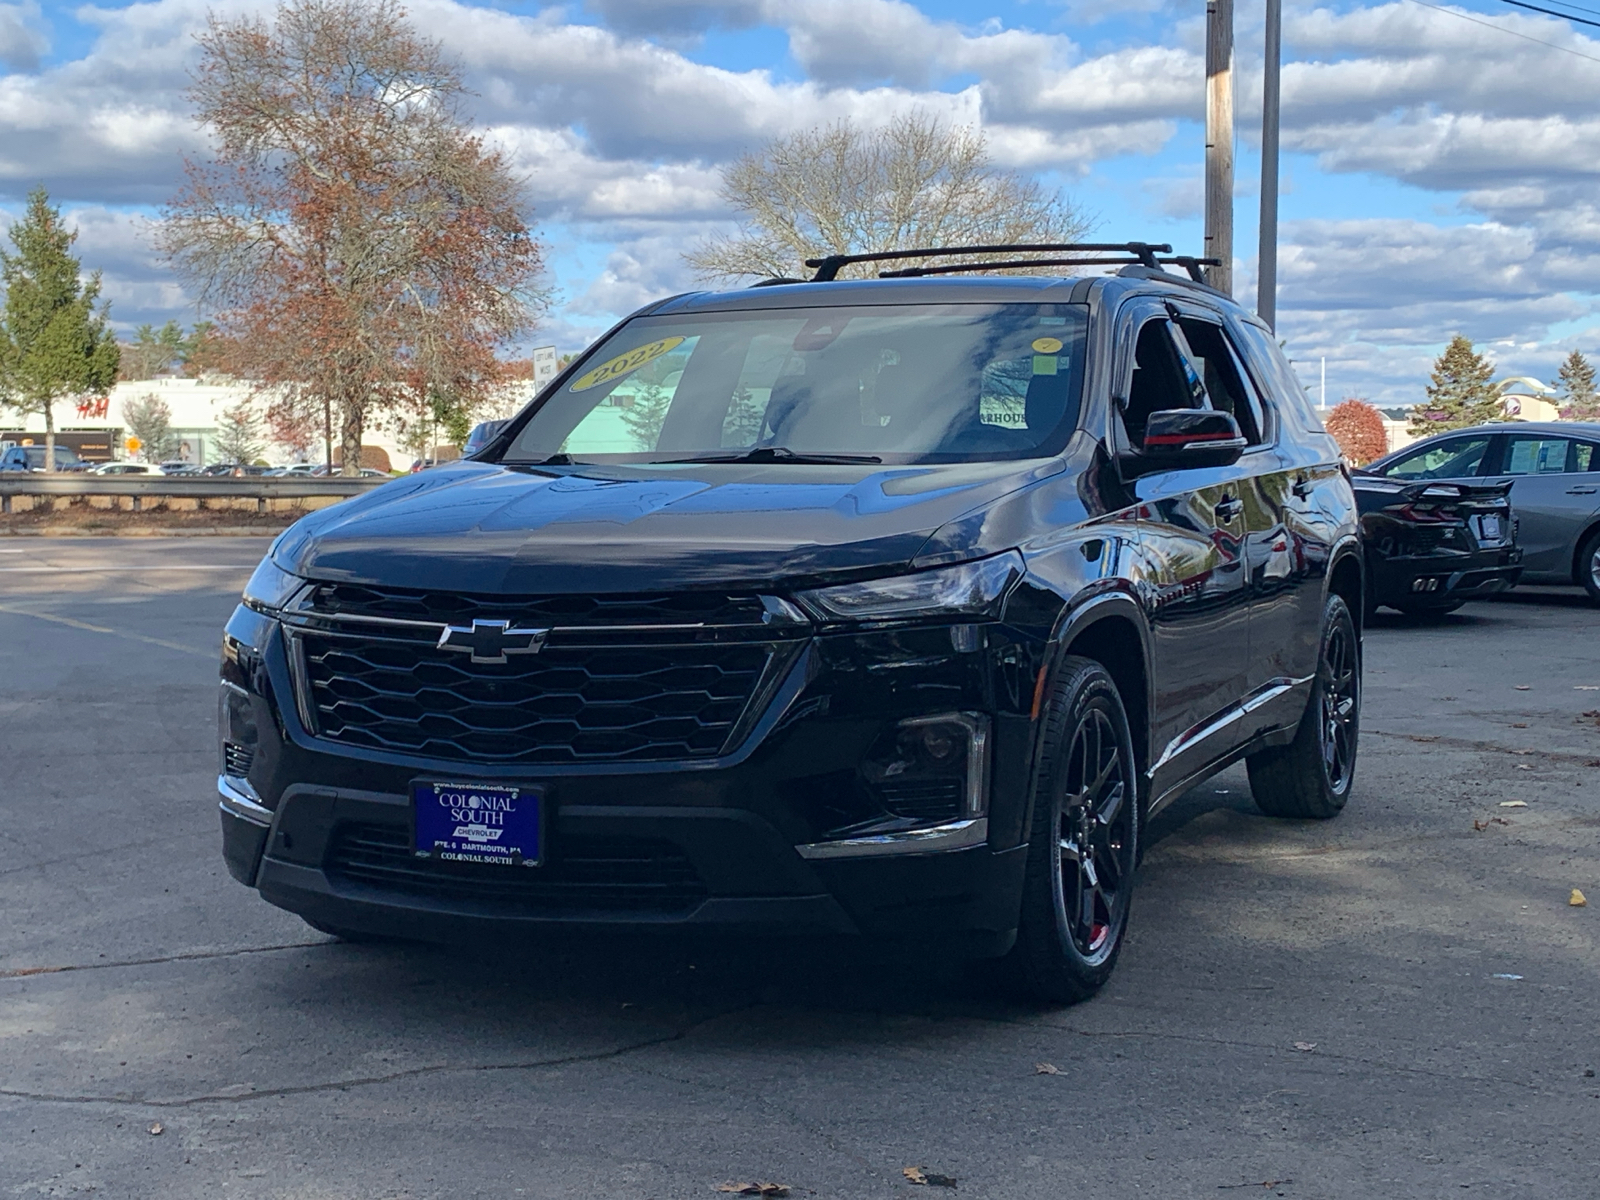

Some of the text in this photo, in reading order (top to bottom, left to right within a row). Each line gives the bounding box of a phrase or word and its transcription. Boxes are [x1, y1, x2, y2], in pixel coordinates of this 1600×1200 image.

[592, 342, 665, 384] 2022
[433, 782, 520, 793] www.buycolonialsouth.com
[439, 793, 516, 812] COLONIAL
[451, 808, 504, 825] SOUTH
[457, 828, 498, 838] CHEVROLET
[451, 841, 457, 849] 6
[461, 843, 509, 854] DARTMOUTH,
[440, 852, 484, 863] COLONIAL
[484, 855, 513, 865] SOUTH
